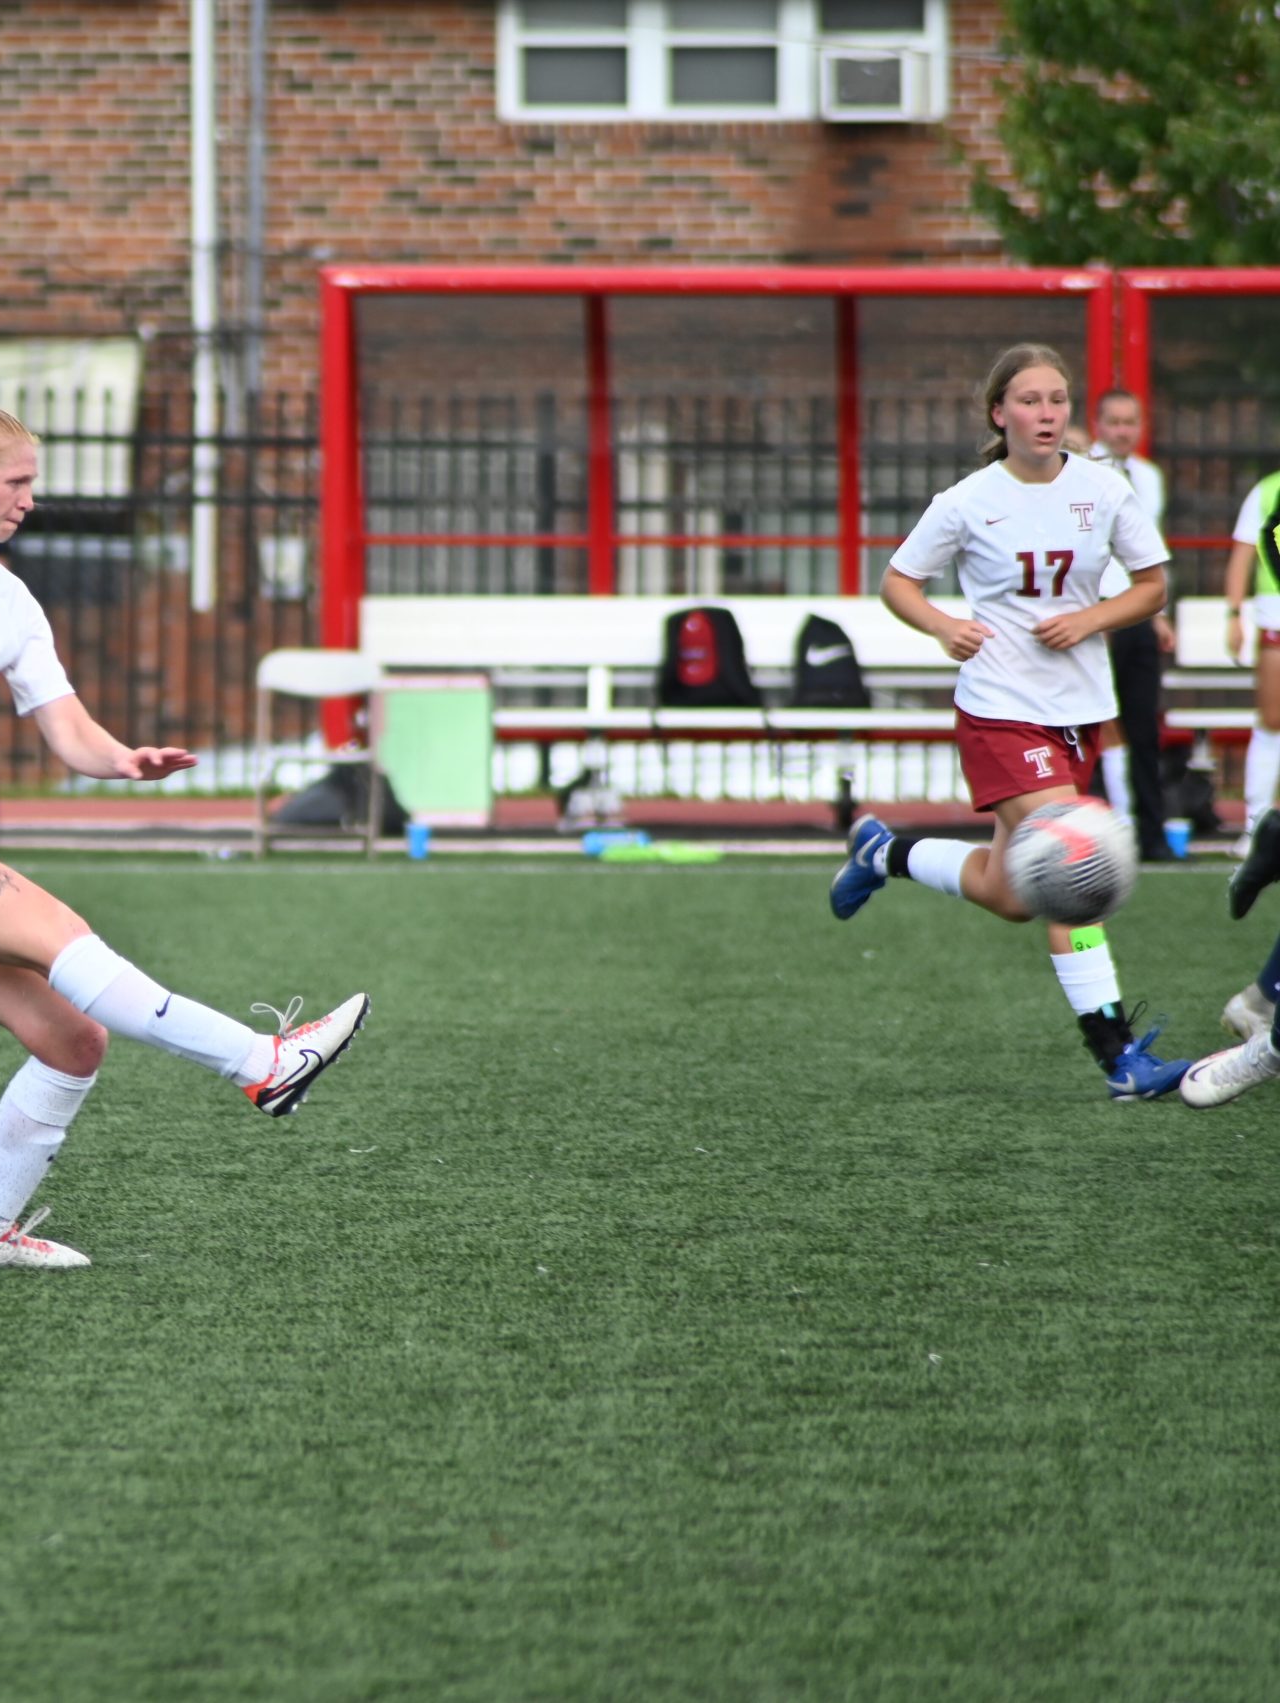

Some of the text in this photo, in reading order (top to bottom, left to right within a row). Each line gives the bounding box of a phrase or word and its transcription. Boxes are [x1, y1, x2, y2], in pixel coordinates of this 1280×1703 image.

[1070, 503, 1094, 532] T
[1016, 550, 1074, 598] 17
[1023, 746, 1054, 778] T
